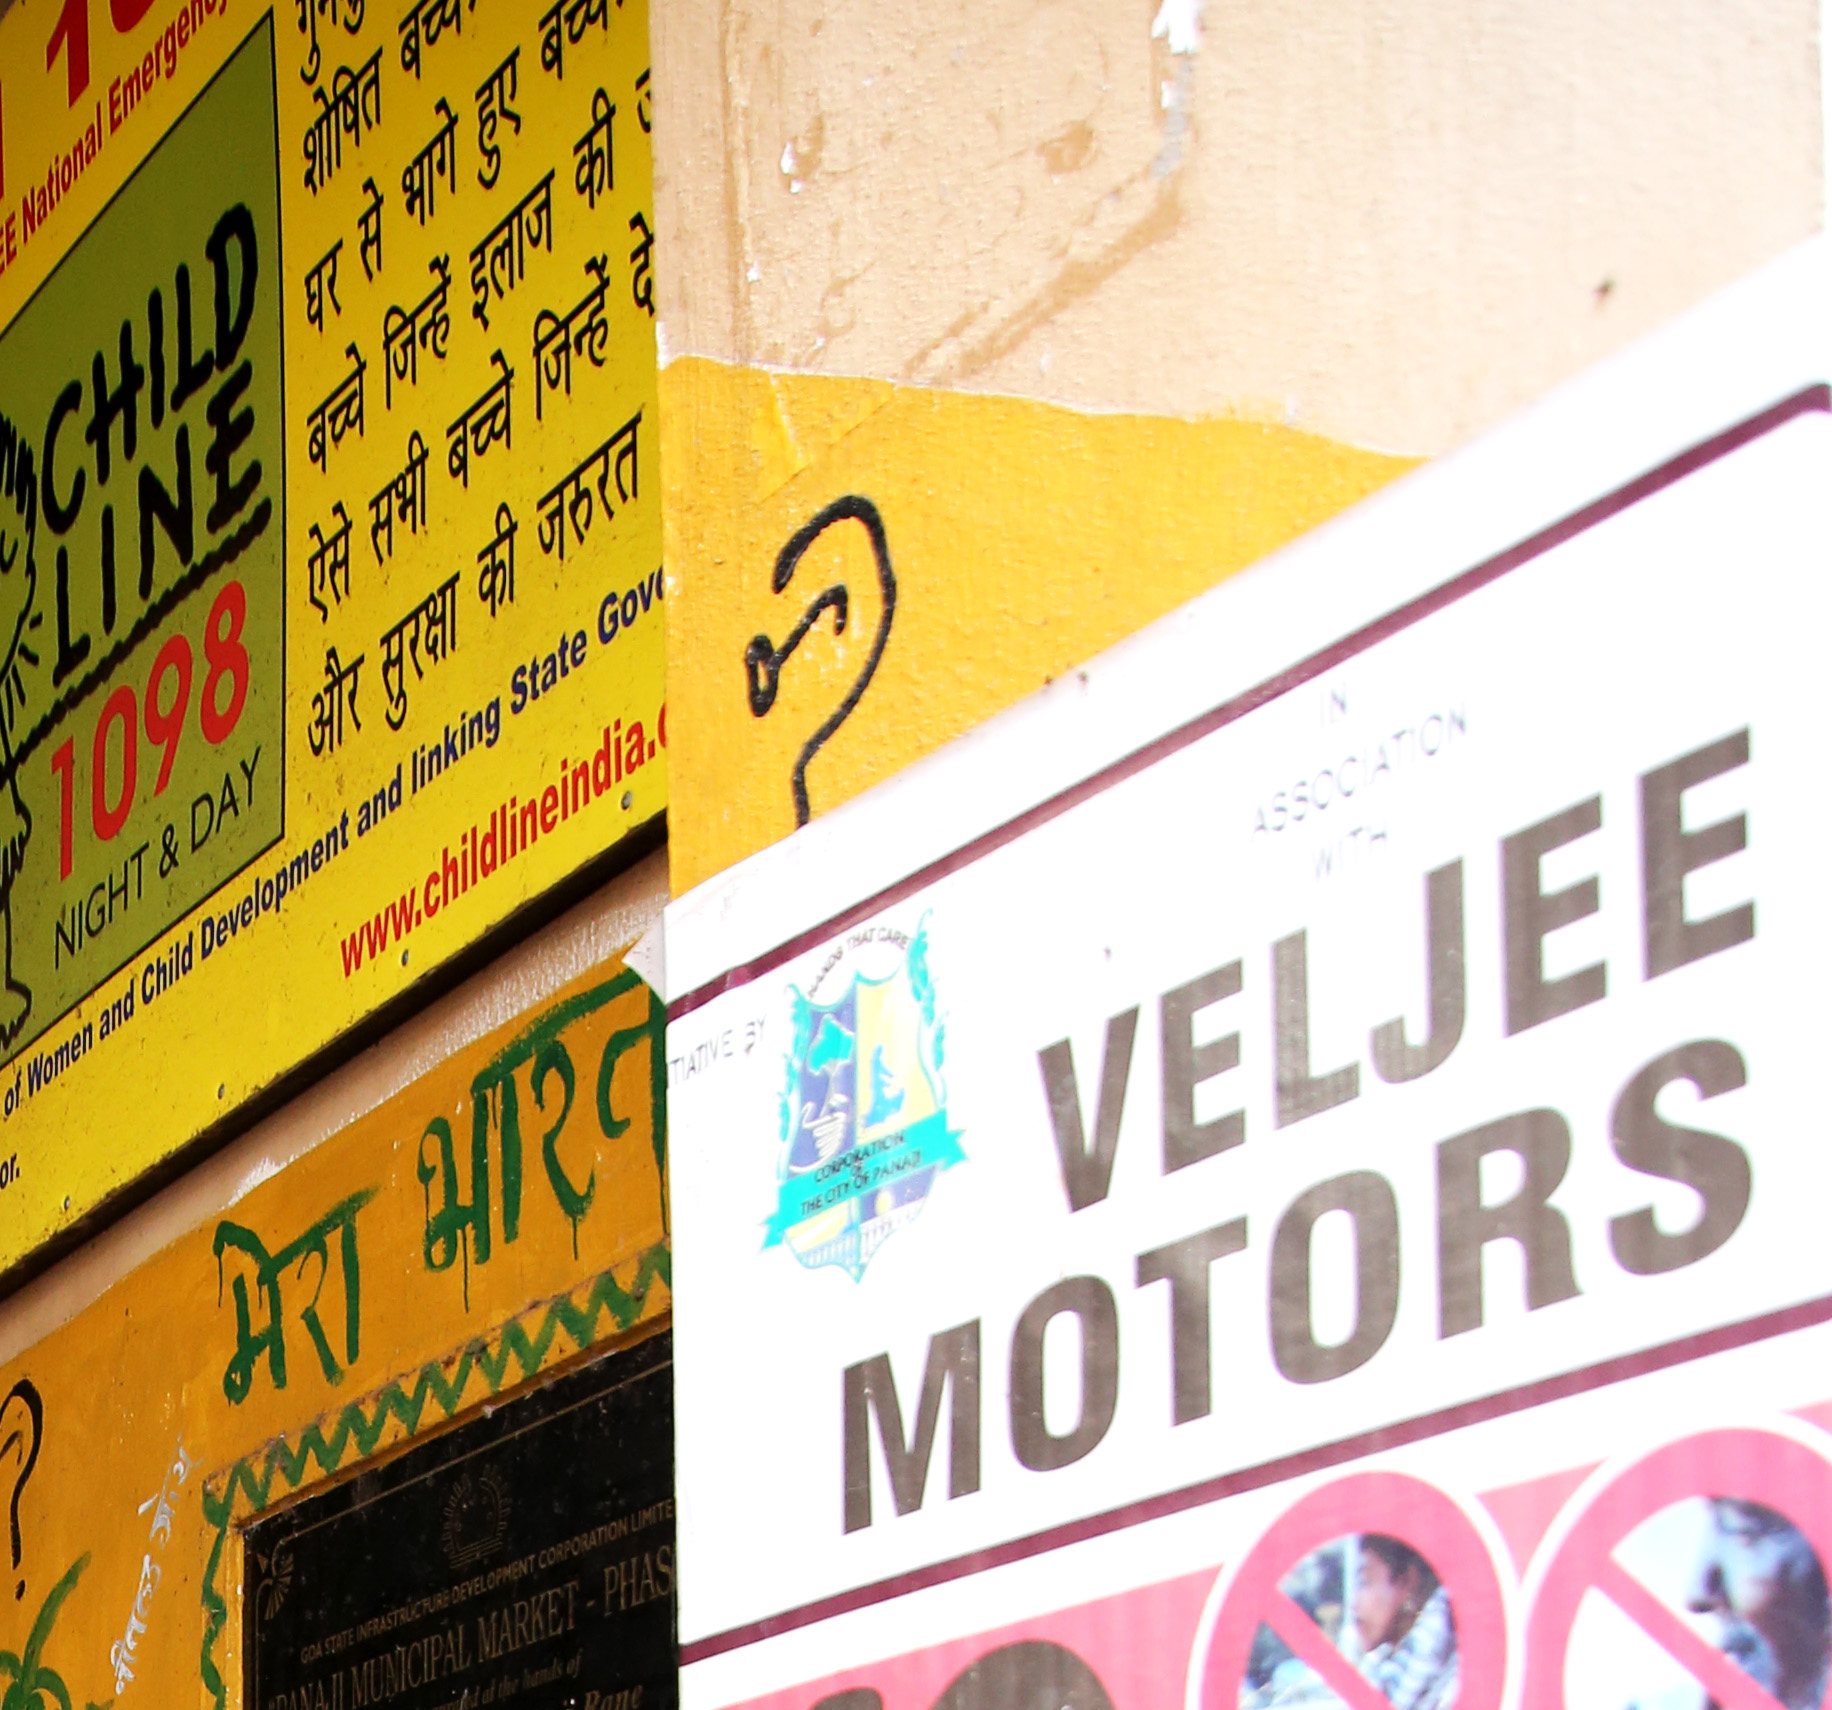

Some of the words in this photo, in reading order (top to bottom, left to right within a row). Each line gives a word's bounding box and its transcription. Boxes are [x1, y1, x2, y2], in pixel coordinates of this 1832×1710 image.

[22, 102, 102, 245] National
[303, 45, 383, 197] शोषित
[304, 237, 343, 332] घर
[358, 176, 384, 283] से
[402, 96, 458, 226] भागे
[475, 45, 521, 190] हुए
[41, 203, 258, 534] CHILD
[306, 342, 366, 474] बच्चे
[469, 168, 555, 332] इलाज
[573, 87, 616, 209] की
[52, 360, 262, 687] LINE
[307, 501, 353, 624] ऐसे
[369, 430, 429, 567] सभी
[447, 349, 514, 488] बच्चे
[50, 580, 250, 884] 1098
[308, 646, 365, 757] और
[380, 570, 461, 731] सुरक्षा
[477, 501, 518, 619] की
[1320, 685, 1348, 728] IN
[2, 1073, 22, 1114] of
[27, 1020, 93, 1098] Women
[99, 978, 135, 1041] and
[141, 928, 194, 1006] Child
[201, 808, 349, 961] Development
[357, 763, 402, 838] and
[410, 695, 501, 795] linking
[511, 629, 588, 716] State
[54, 841, 150, 972] NIGHT
[158, 823, 180, 880] &
[190, 745, 262, 855] DAY
[1252, 703, 1470, 841] ASSOCIATION
[1312, 820, 1392, 881] WITH
[846, 927, 876, 950] THAT
[878, 926, 909, 950] CARE
[1037, 723, 1756, 1215] VELJEE
[800, 1191, 822, 1217] THE
[824, 1175, 852, 1209] CITY
[854, 1170, 870, 1191] OF
[814, 1129, 908, 1184] CORPORATION
[841, 1035, 1755, 1537] MOTORS
[300, 1645, 323, 1665] GOA
[324, 1631, 354, 1655] STATE
[356, 1592, 450, 1643] INFRASTRUCTURE
[451, 1554, 535, 1603] DEVELOPMENT
[538, 1519, 627, 1569] CORPORATION
[350, 1624, 471, 1710] MUNICIPAL
[477, 1580, 581, 1664] MARKET
